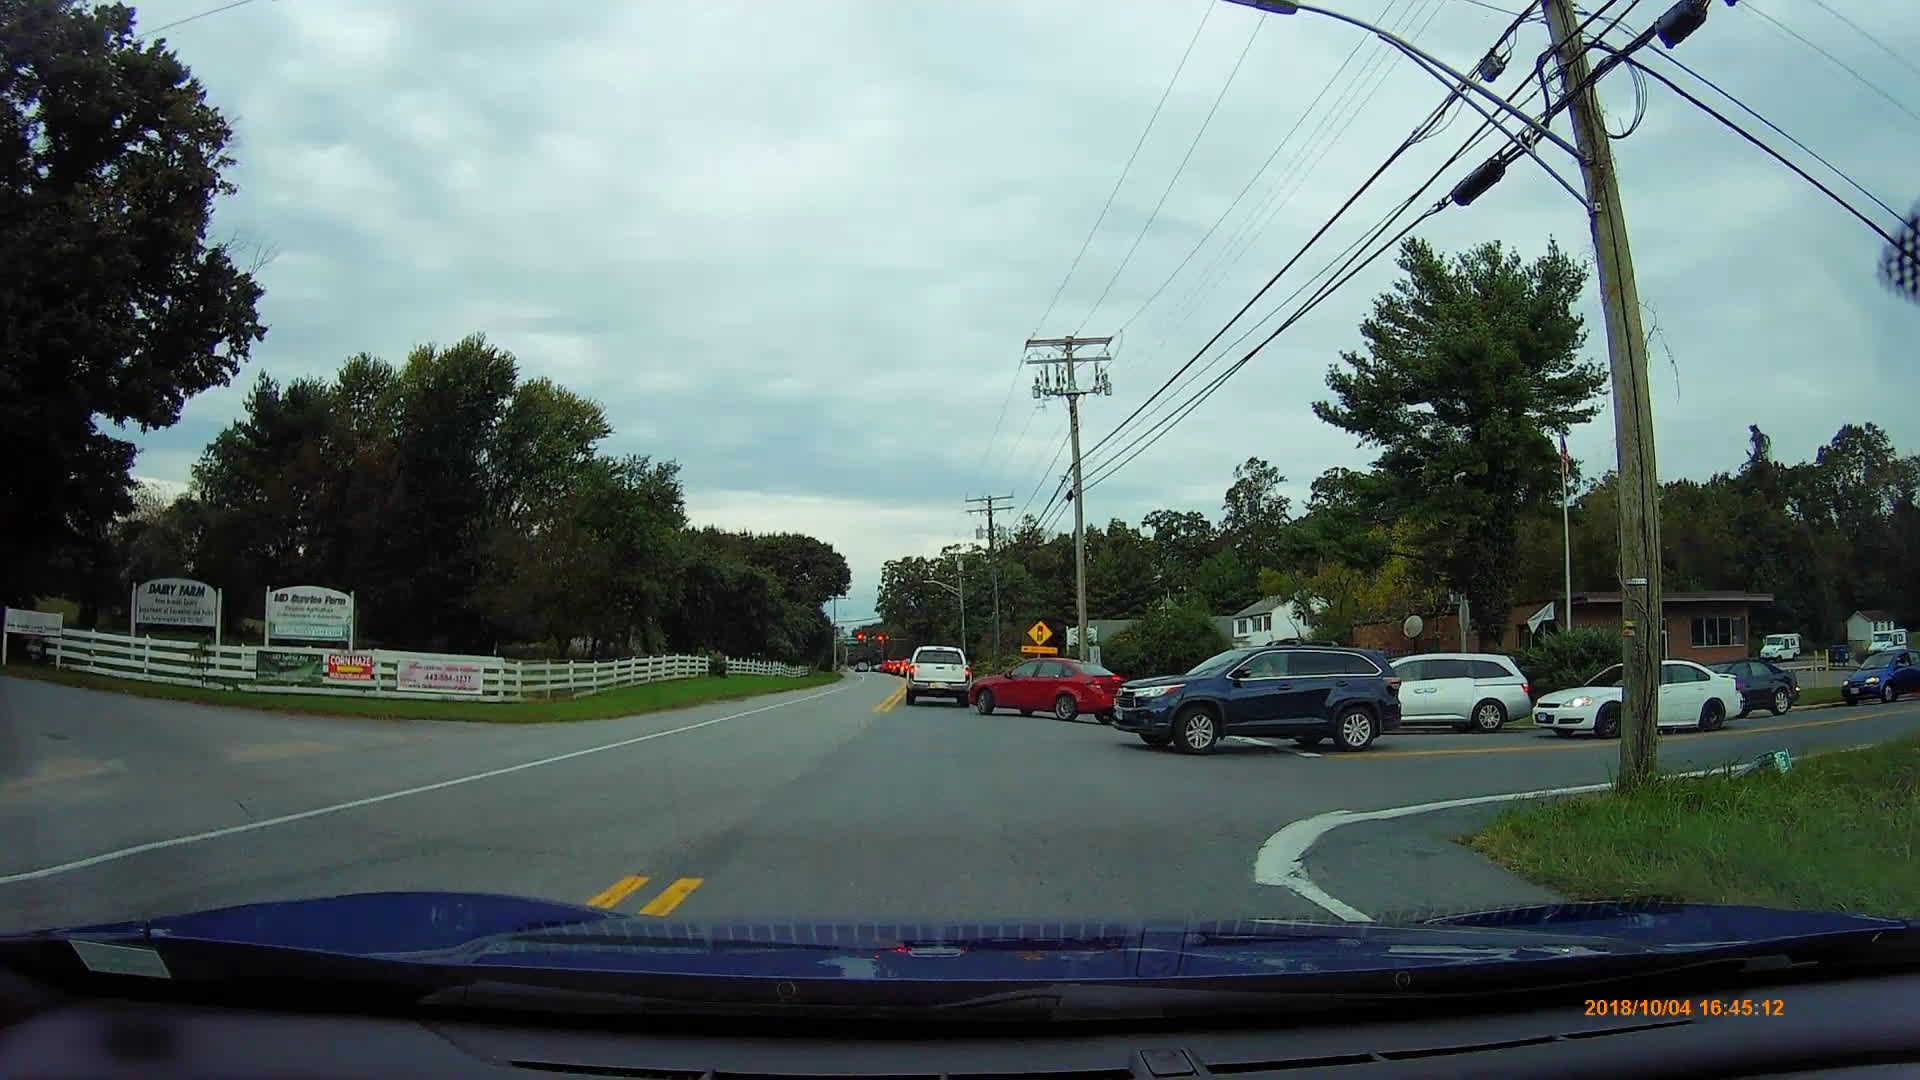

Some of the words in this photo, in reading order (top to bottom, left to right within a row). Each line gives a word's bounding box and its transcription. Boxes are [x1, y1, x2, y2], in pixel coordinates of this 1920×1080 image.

[148, 583, 177, 595] DAIRY
[179, 585, 206, 597] FARM
[330, 655, 350, 665] CORN
[351, 655, 371, 666] MAZE
